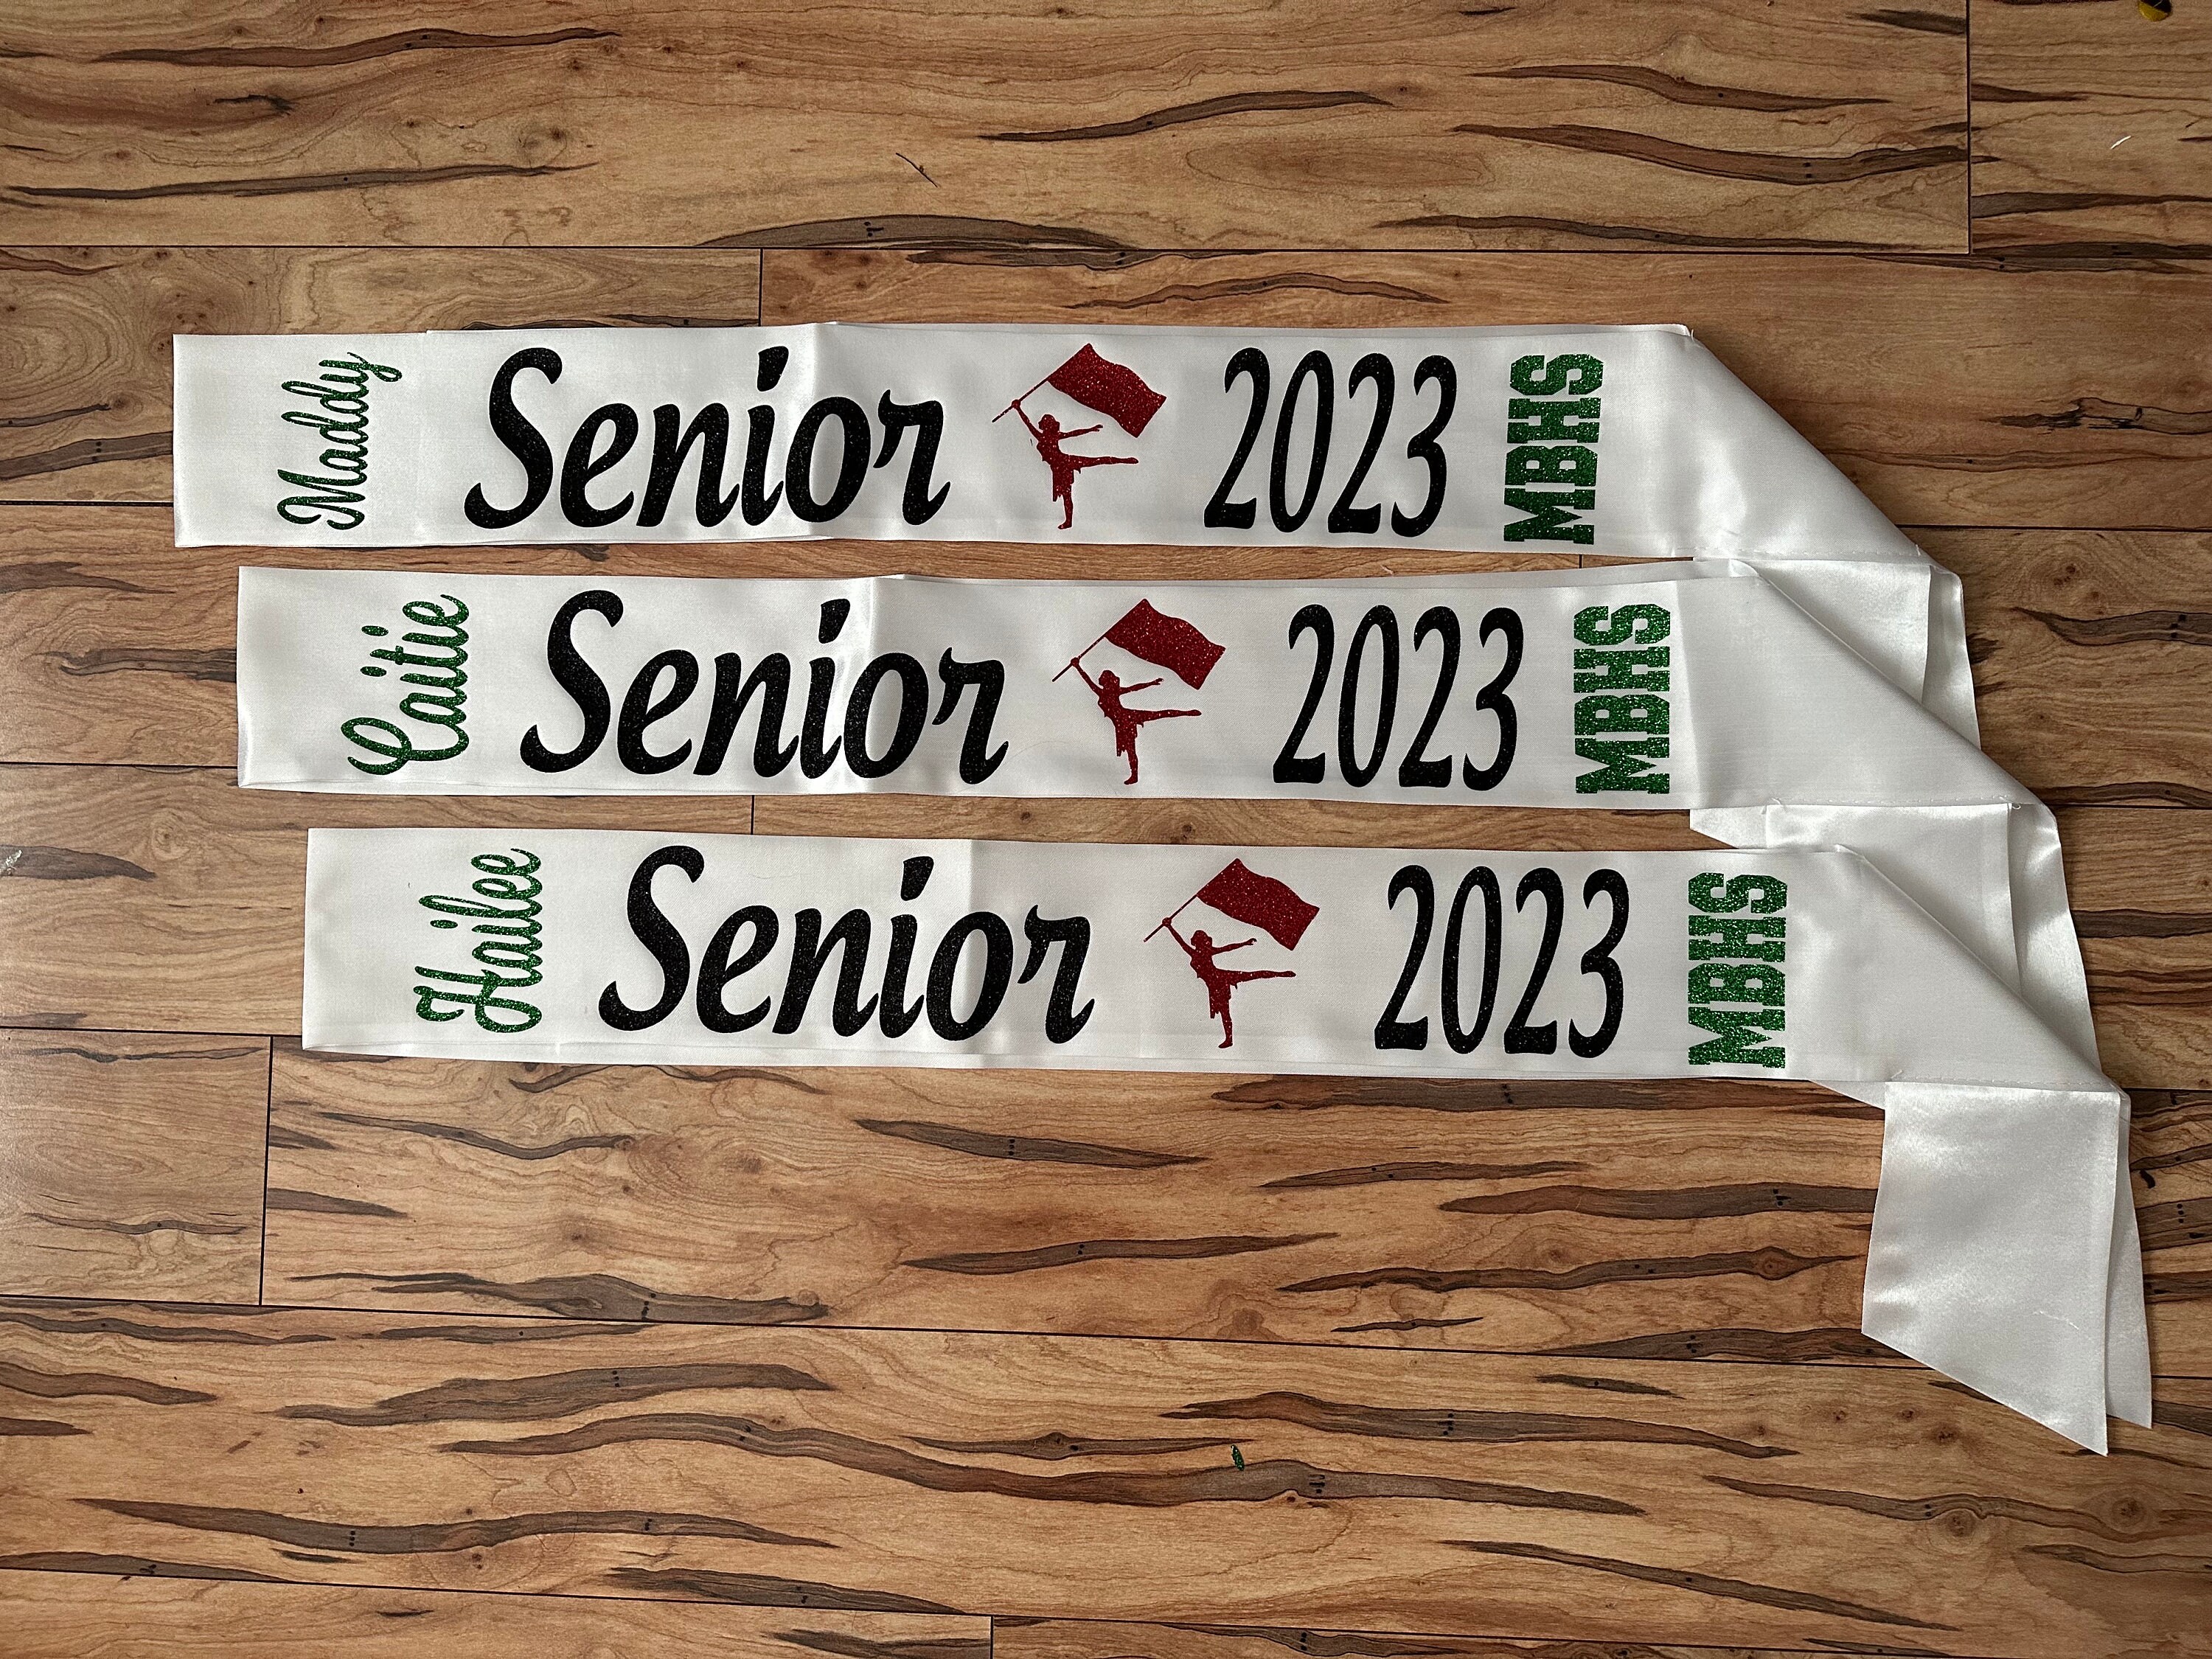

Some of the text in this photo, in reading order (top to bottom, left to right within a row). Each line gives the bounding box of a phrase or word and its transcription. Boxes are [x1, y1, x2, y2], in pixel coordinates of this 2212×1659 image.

[277, 352, 402, 530] Maddy
[465, 347, 1456, 537] Senior 2023
[1504, 355, 1603, 544] MBHS
[341, 594, 469, 775] Caitie
[520, 590, 1523, 790] Senior 2023
[1574, 604, 1671, 793] MBHS
[414, 848, 543, 1032] Hailee
[599, 846, 1629, 1058] Senior 2023
[1688, 873, 1787, 1068] MBHS
